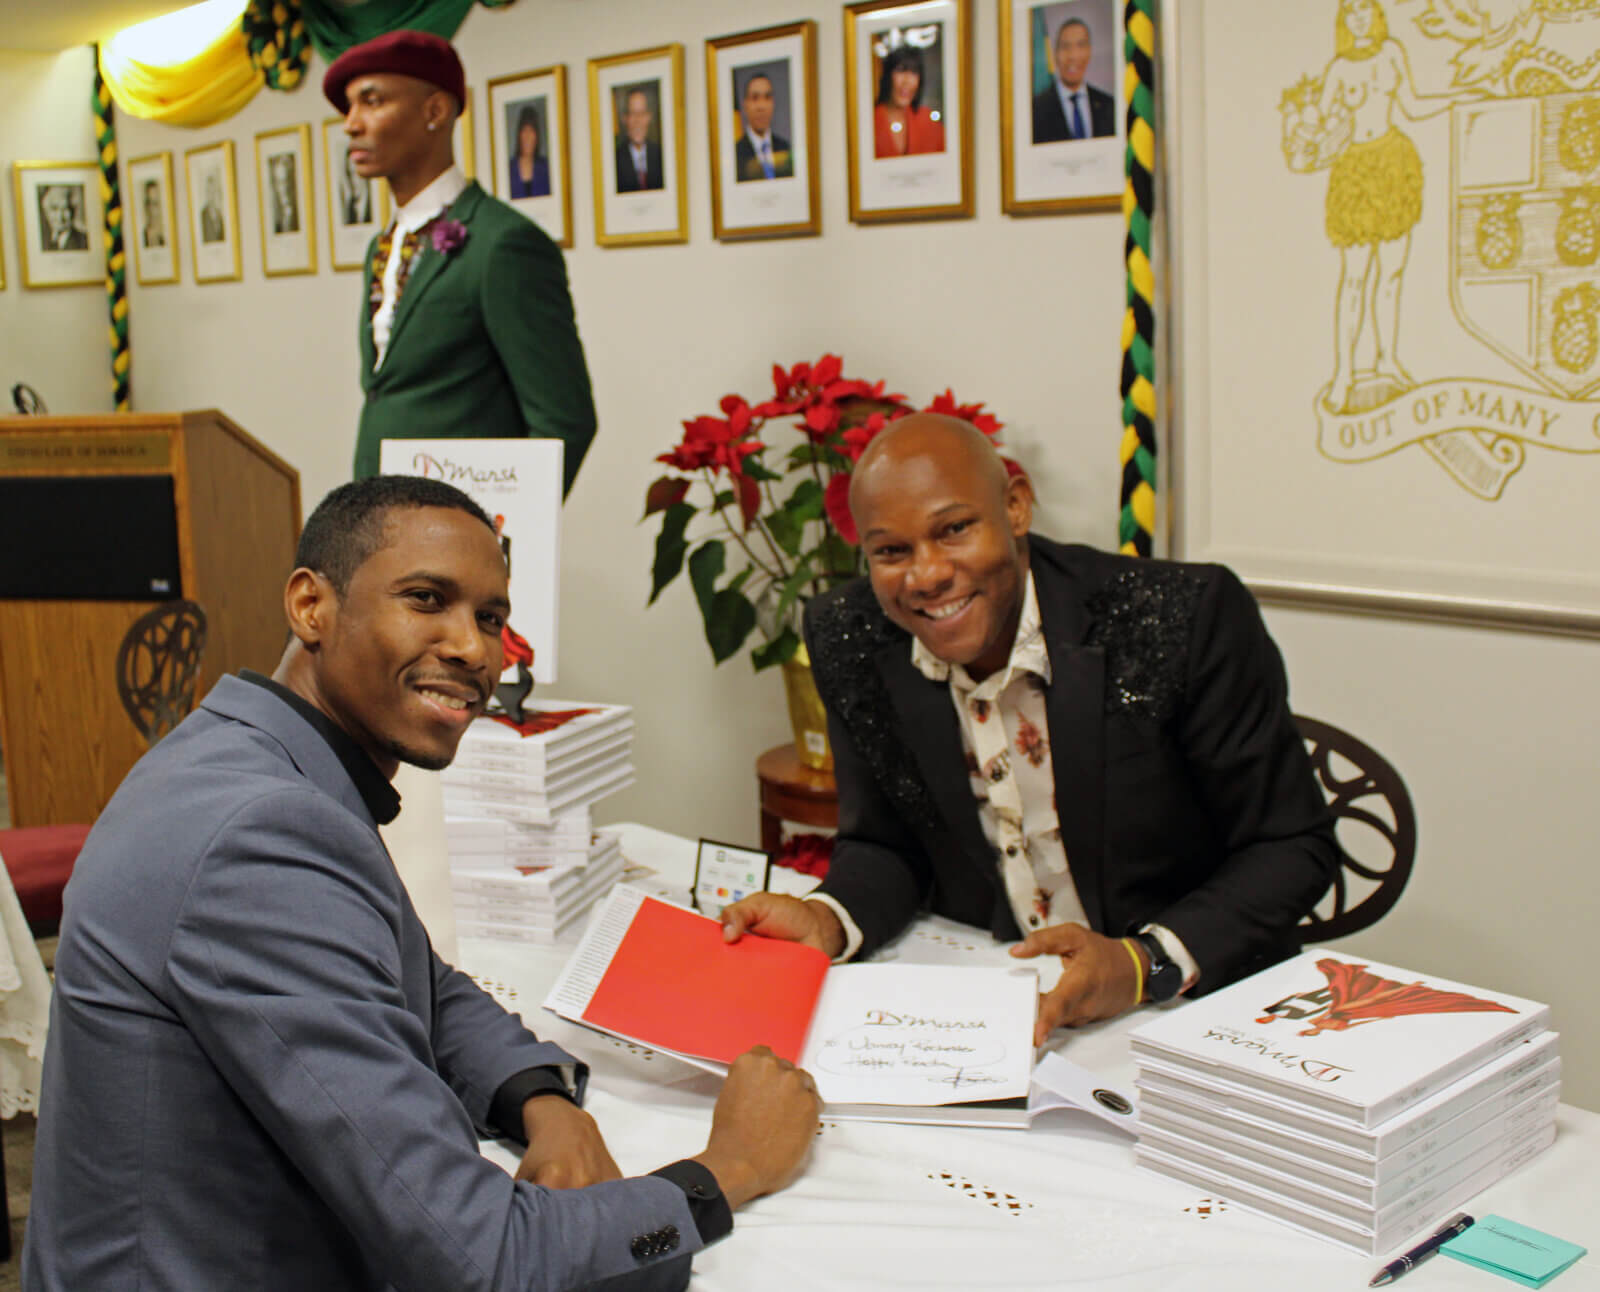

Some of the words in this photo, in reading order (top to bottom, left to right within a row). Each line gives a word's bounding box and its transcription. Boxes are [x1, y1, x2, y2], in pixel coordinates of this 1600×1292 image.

[1338, 408, 1396, 449] OUT
[1411, 390, 1449, 425] OF
[1458, 387, 1560, 437] MANY
